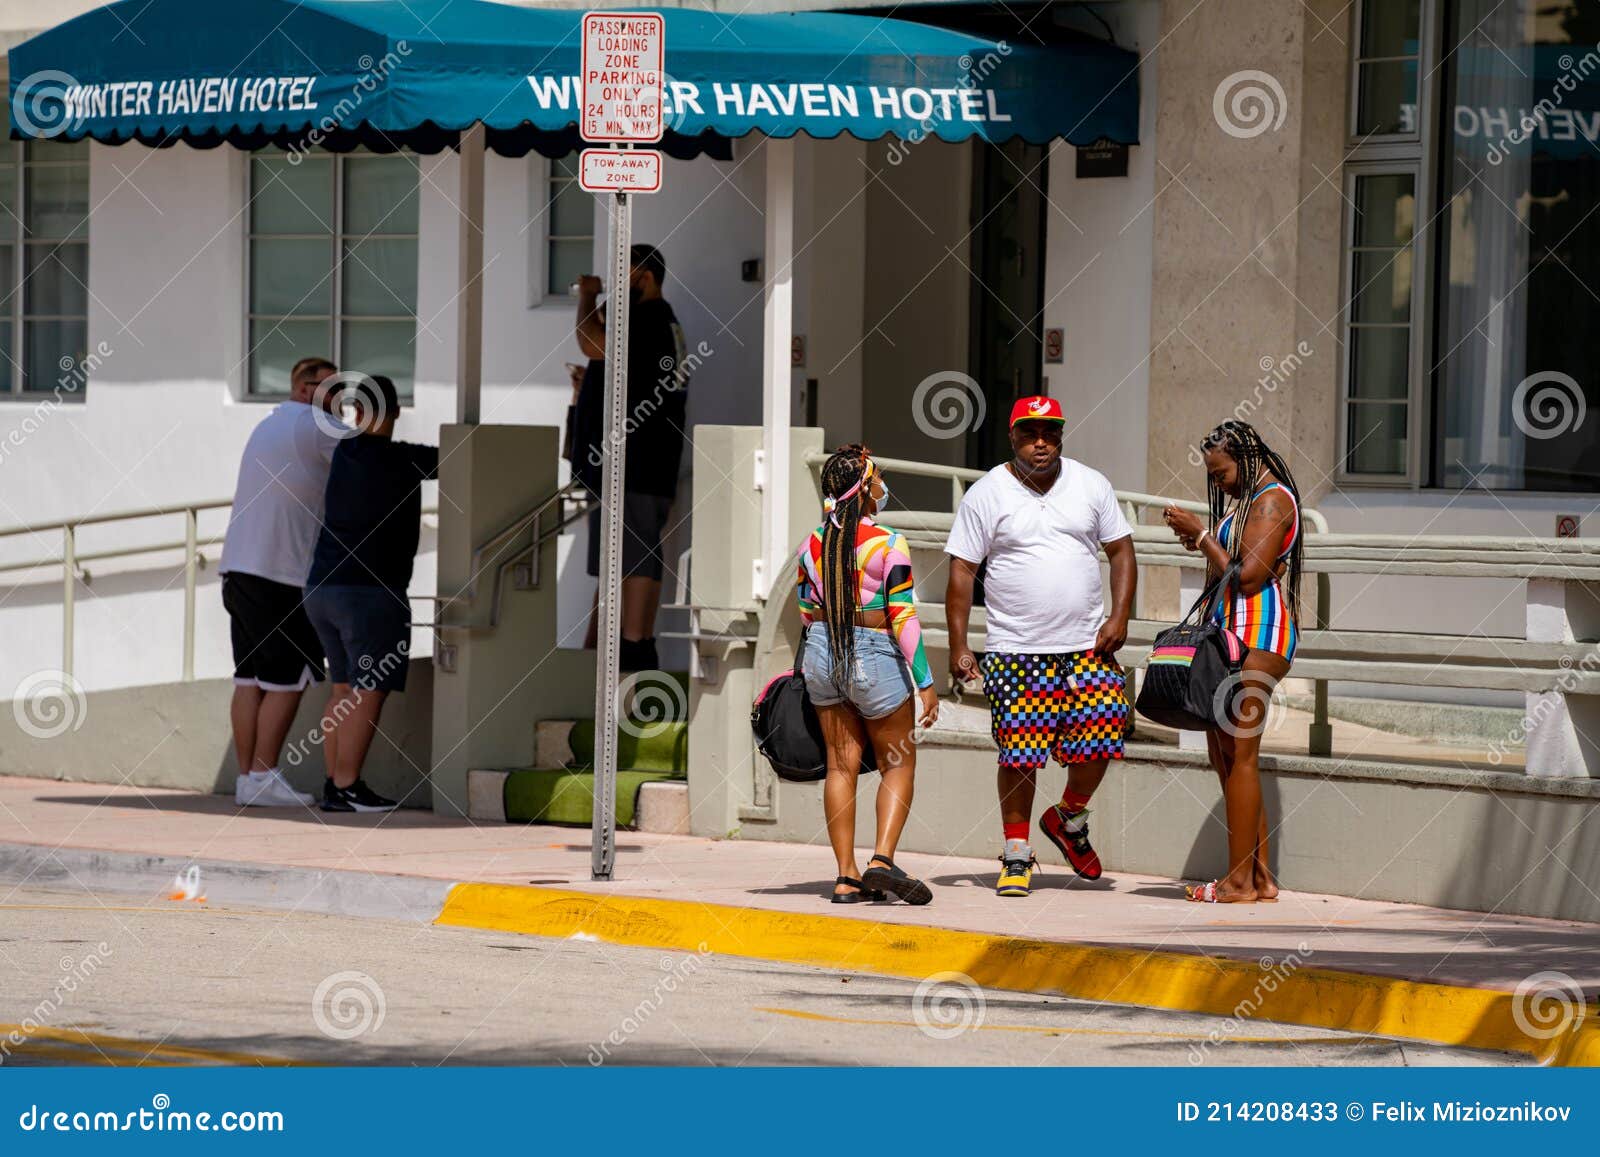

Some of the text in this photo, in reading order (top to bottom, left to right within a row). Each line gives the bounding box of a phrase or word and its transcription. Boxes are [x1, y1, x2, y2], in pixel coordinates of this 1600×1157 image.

[598, 38, 648, 52] LOADING
[605, 54, 640, 69] ZONE
[589, 70, 656, 85] PARKING
[63, 76, 319, 119] WINTER HAVEN HOTEL
[527, 75, 1013, 122] WIR HAVEN HOTEL
[602, 87, 641, 101] ONLY
[588, 103, 655, 118] 24 HOURS
[588, 120, 597, 133] 15
[593, 159, 650, 169] TOW-AWAY
[606, 173, 635, 183] ZONE
